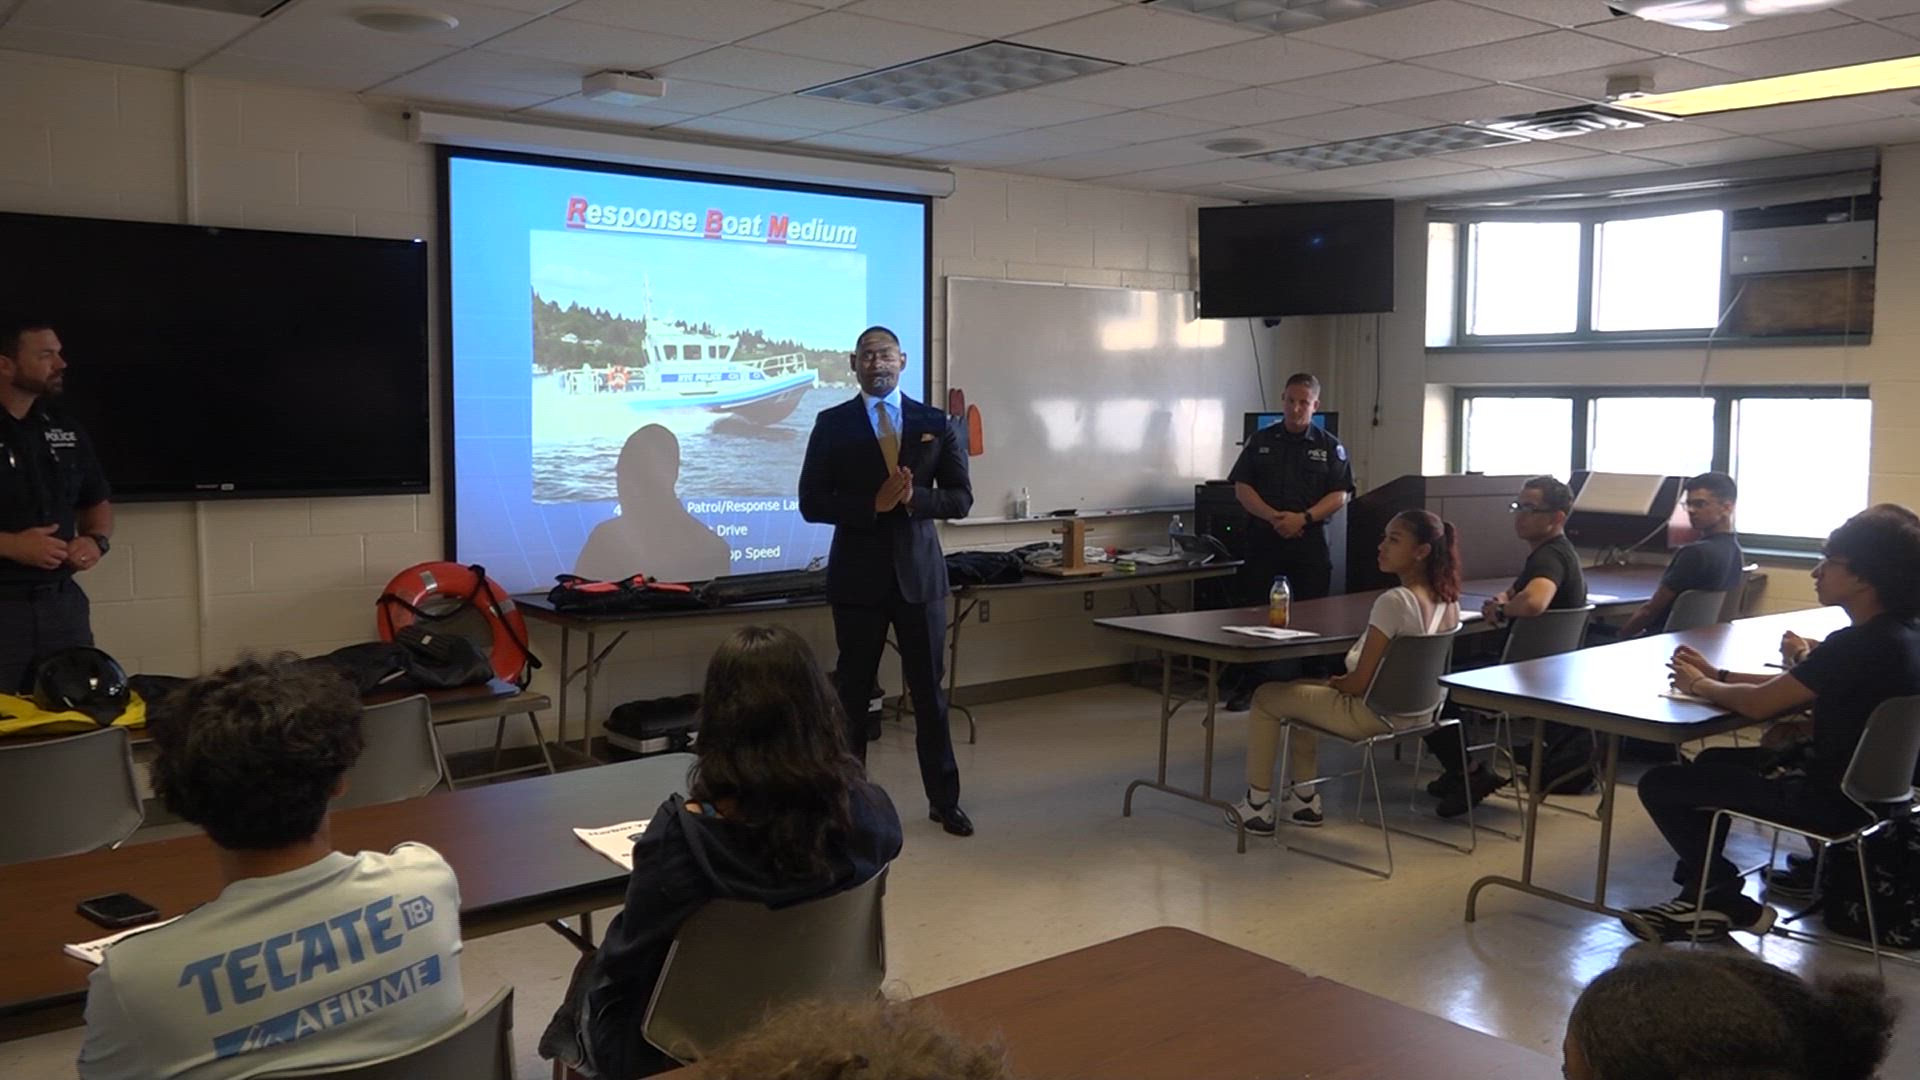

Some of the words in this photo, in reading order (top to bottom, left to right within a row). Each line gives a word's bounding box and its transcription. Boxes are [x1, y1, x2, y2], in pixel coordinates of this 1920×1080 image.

[567, 197, 698, 232] Response
[704, 208, 762, 237] Boat
[768, 214, 858, 244] Medium
[44, 431, 77, 441] POLICE
[687, 500, 780, 514] Patrol/Response
[716, 523, 749, 537] Drive
[745, 546, 781, 560] Speed
[177, 895, 404, 1016] TECATE
[403, 901, 433, 927] 18+
[294, 957, 434, 1040] AFIRME
